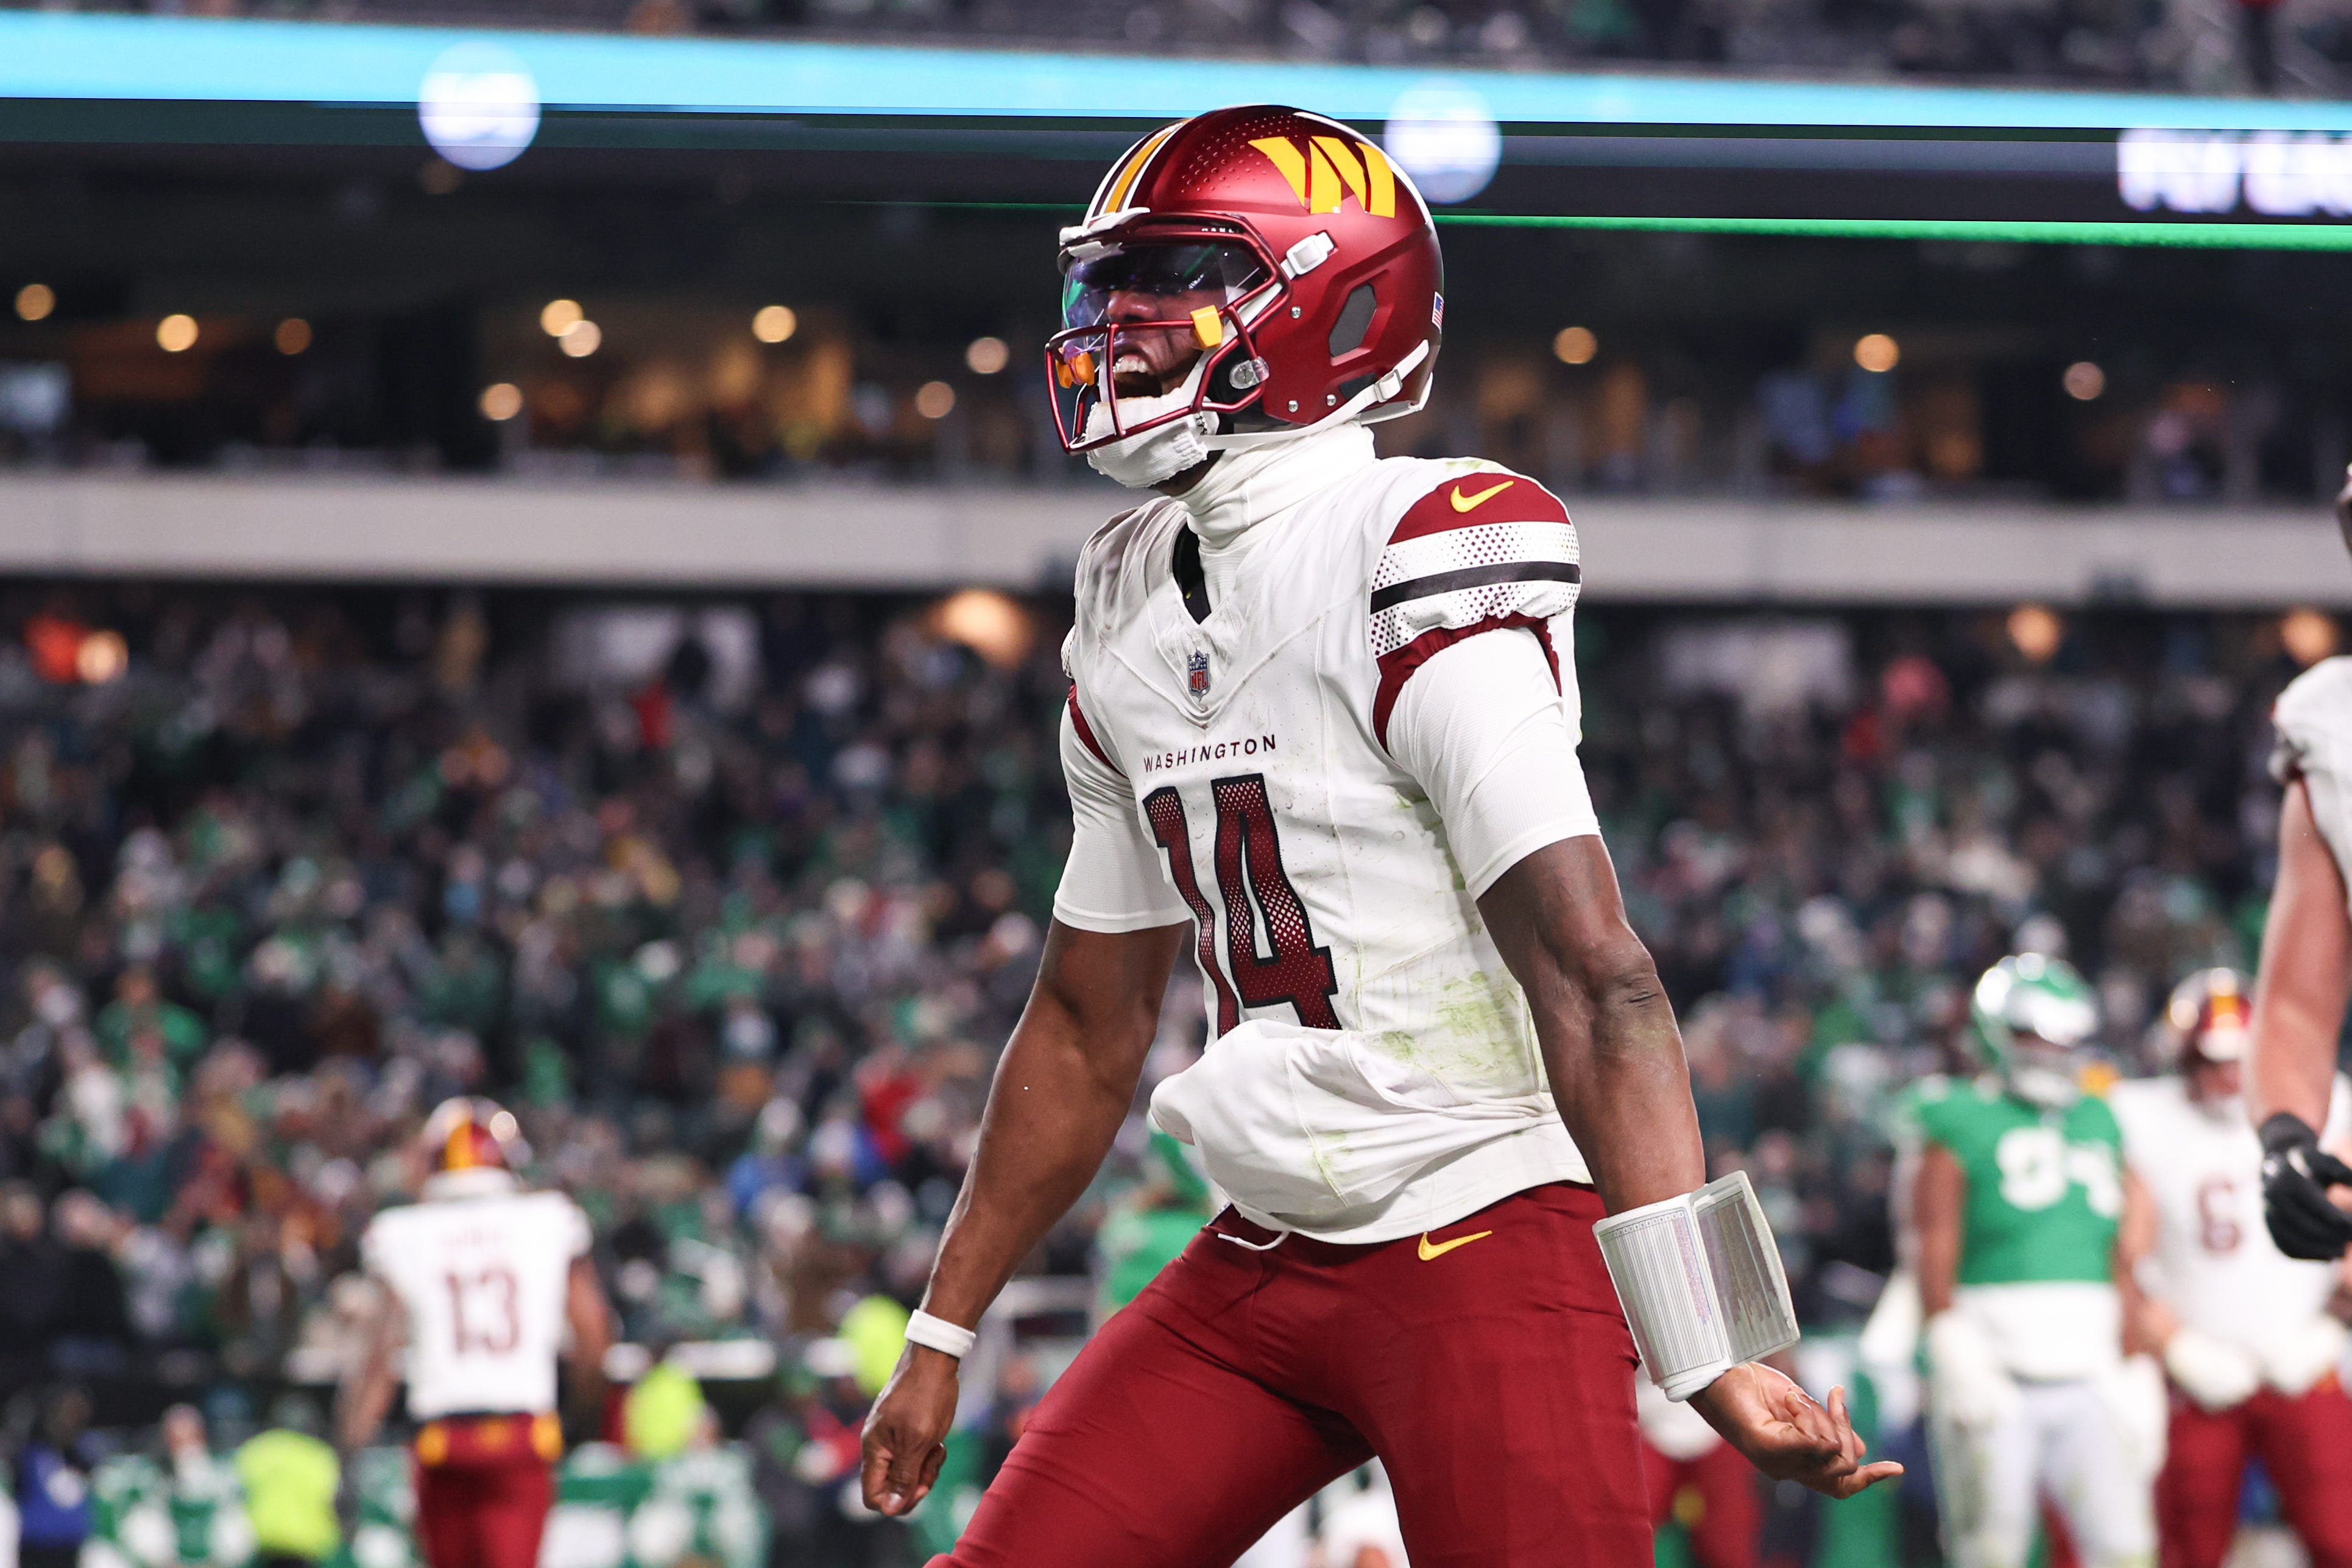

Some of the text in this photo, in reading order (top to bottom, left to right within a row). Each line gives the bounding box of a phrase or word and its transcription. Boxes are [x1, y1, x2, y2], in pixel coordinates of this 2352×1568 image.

[1191, 671, 1207, 690] NFL
[1143, 734, 1276, 772] WASHINGTON
[1143, 772, 1342, 1039] 14
[444, 1260, 521, 1357] 13
